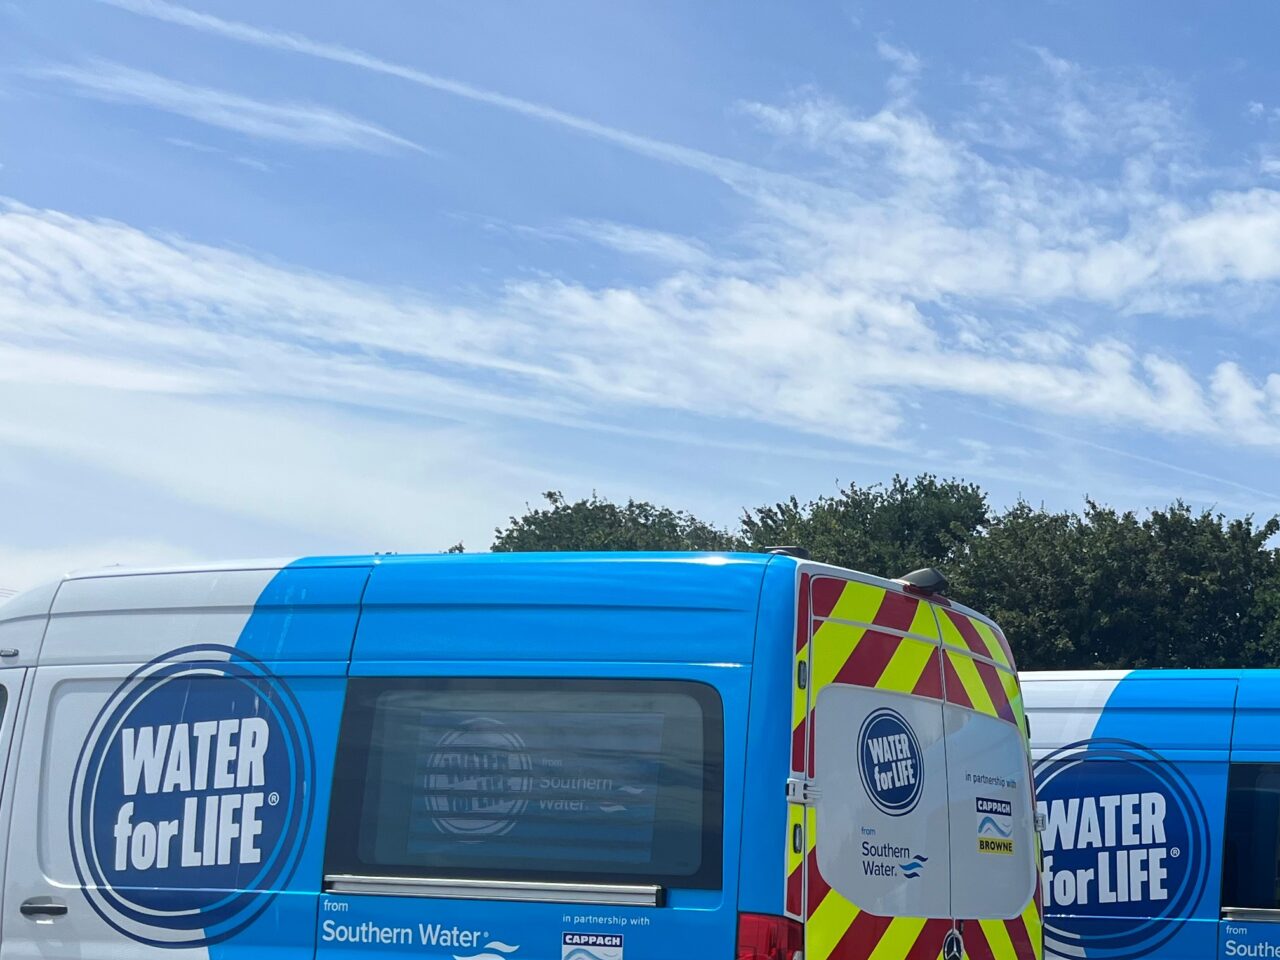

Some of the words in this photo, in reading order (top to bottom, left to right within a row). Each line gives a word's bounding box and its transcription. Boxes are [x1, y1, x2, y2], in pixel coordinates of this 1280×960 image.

[868, 733, 911, 764] WATER
[122, 717, 269, 796] WATER
[965, 773, 972, 782] in
[973, 774, 1005, 787] partnership
[1006, 779, 1017, 789] with
[977, 800, 1011, 813] CAPPAGH
[1036, 792, 1167, 851] WATER
[861, 826, 876, 835] from
[862, 841, 910, 859] Southern
[979, 840, 1012, 852] BROWNE
[324, 899, 348, 912] from
[562, 914, 571, 923] in
[574, 914, 627, 926] partnership
[630, 915, 650, 926] with
[322, 920, 412, 944] Southern
[419, 924, 481, 948] Water
[1226, 925, 1247, 935] from
[565, 934, 621, 946] CAPPAGH
